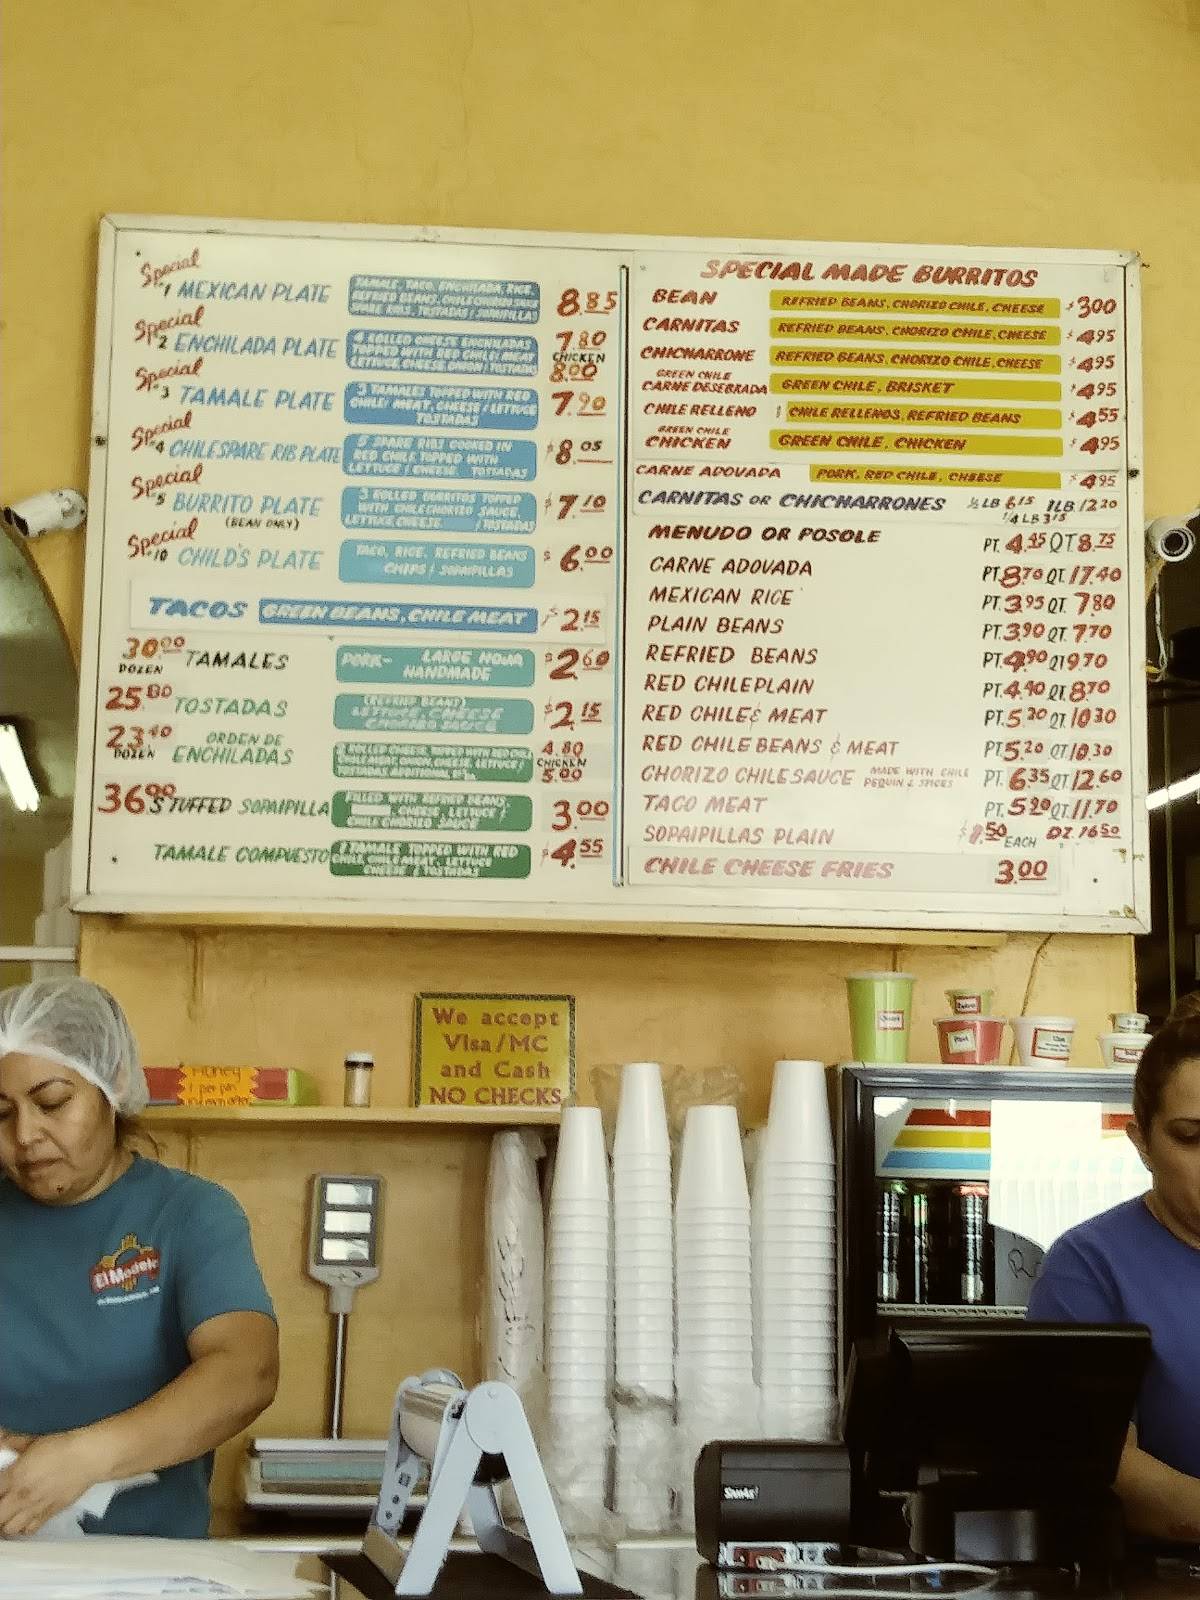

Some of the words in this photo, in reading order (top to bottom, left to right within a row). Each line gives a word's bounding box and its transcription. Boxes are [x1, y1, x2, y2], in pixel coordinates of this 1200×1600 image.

[141, 248, 200, 287] Special
[700, 260, 815, 281] SPECIAL
[821, 262, 908, 283] MADE
[912, 265, 1038, 287] BURRITOS
[177, 280, 266, 301] MEXICAN
[272, 284, 332, 303] PLATE
[652, 288, 717, 305] BEAN
[557, 287, 618, 317] 8.85
[781, 296, 837, 307] REFRIED
[892, 300, 947, 311] CHORIZO
[992, 302, 1045, 314] CHEESE
[135, 304, 204, 344] Special
[642, 317, 740, 333] CARNITAS
[778, 322, 832, 334] REFRIED
[892, 327, 949, 338] CHORIZO
[998, 329, 1047, 341] CHEESE
[174, 333, 276, 354] ENCHILADA
[282, 337, 340, 358] PLATE
[640, 346, 755, 362] CHICHARRONE
[552, 352, 605, 363] CHICKEN
[775, 350, 834, 363] REFRIED
[890, 354, 950, 366] CHORIZO
[996, 358, 1044, 370] CHEESE
[136, 356, 203, 391] Special
[656, 368, 695, 379] GREEN
[698, 370, 732, 381] CHILE
[641, 381, 691, 392] CARNE
[782, 379, 831, 391] GREEN
[886, 380, 955, 394] BRISKET
[180, 385, 268, 408] TAMALE
[275, 390, 336, 411] PLATE
[551, 391, 607, 417] 7.90
[643, 403, 688, 416] CHILE
[689, 403, 758, 418] RELLENO
[788, 406, 828, 418] CHILE
[907, 410, 970, 423] REFRIED
[972, 412, 1022, 425] BEANS
[131, 410, 192, 451] Special
[657, 425, 693, 435] GREEN
[696, 426, 731, 436] CHILE
[645, 436, 732, 450] CHICKEN
[778, 434, 832, 447] GREEN
[894, 437, 968, 451] CHICKEN
[270, 443, 298, 461] RIB
[298, 445, 342, 464] PLATE
[131, 463, 203, 500] Special
[636, 464, 695, 476] CARNE
[699, 466, 781, 479] ADOVADA
[863, 470, 893, 481] RED
[948, 472, 1003, 483] CHEESE
[172, 492, 252, 514] BURRITO
[259, 495, 324, 517] PLATE
[638, 490, 744, 507] CARNITAS
[778, 493, 947, 511] CHICHARRONES
[982, 498, 1000, 508] LB
[1022, 514, 1040, 523] LB
[128, 518, 198, 559] Special
[648, 525, 752, 540] MENUDO
[762, 527, 790, 541] OR
[798, 527, 882, 544] POSOLE
[256, 549, 324, 570] PLATE
[650, 556, 715, 574] CARNE
[722, 557, 812, 576] ADOVADA
[649, 586, 740, 604] MEXICAN
[751, 588, 793, 605] RICE
[149, 597, 248, 618] TACOS
[262, 603, 327, 618] GREEN
[407, 609, 466, 624] CHILE
[467, 610, 528, 625] MEAT
[648, 615, 707, 633] PLAIN
[716, 617, 784, 634] BEANS
[184, 649, 289, 671] TAMALES
[645, 644, 735, 664] REFRIED
[751, 647, 818, 665] BEANS
[118, 663, 163, 675] DOZEN
[402, 665, 492, 682] HANDMADE
[644, 674, 685, 692] RED
[174, 696, 289, 718] TOSTADAS
[641, 704, 682, 722] RED
[767, 707, 828, 724] MEAT
[205, 731, 261, 746] ORDEN
[263, 733, 285, 747] DE
[642, 735, 682, 752] RED
[691, 736, 751, 752] CHILE
[756, 738, 822, 754] BEANS
[847, 741, 899, 756] MEAT
[113, 749, 156, 760] DOZEN
[171, 746, 294, 766] ENCHILADAS
[536, 757, 587, 768] CHICKEN
[641, 765, 728, 783] CHORIZO
[870, 766, 900, 776] MADE
[905, 767, 933, 777] WITH
[148, 795, 233, 816] STUFFED
[237, 798, 330, 818] SOPAIPILLA
[643, 794, 697, 812] TACO
[705, 796, 768, 813] MEAT
[551, 799, 610, 832] 3.00
[643, 824, 764, 845] SOPAIPILLAS
[773, 828, 834, 845] PLAIN
[1004, 836, 1037, 848] EACH
[153, 843, 232, 863] TAMALE
[235, 846, 330, 866] COMPUESTO
[643, 856, 718, 875] CHILE
[723, 857, 817, 878] CHEESE
[820, 860, 895, 879] FRIES
[995, 859, 1049, 885] 3.00
[432, 1007, 468, 1025] We
[481, 1010, 560, 1030] accept
[440, 1060, 482, 1078] and
[494, 1061, 550, 1078] Cash
[429, 1086, 466, 1105] NO
[474, 1087, 561, 1105] CHECKS
